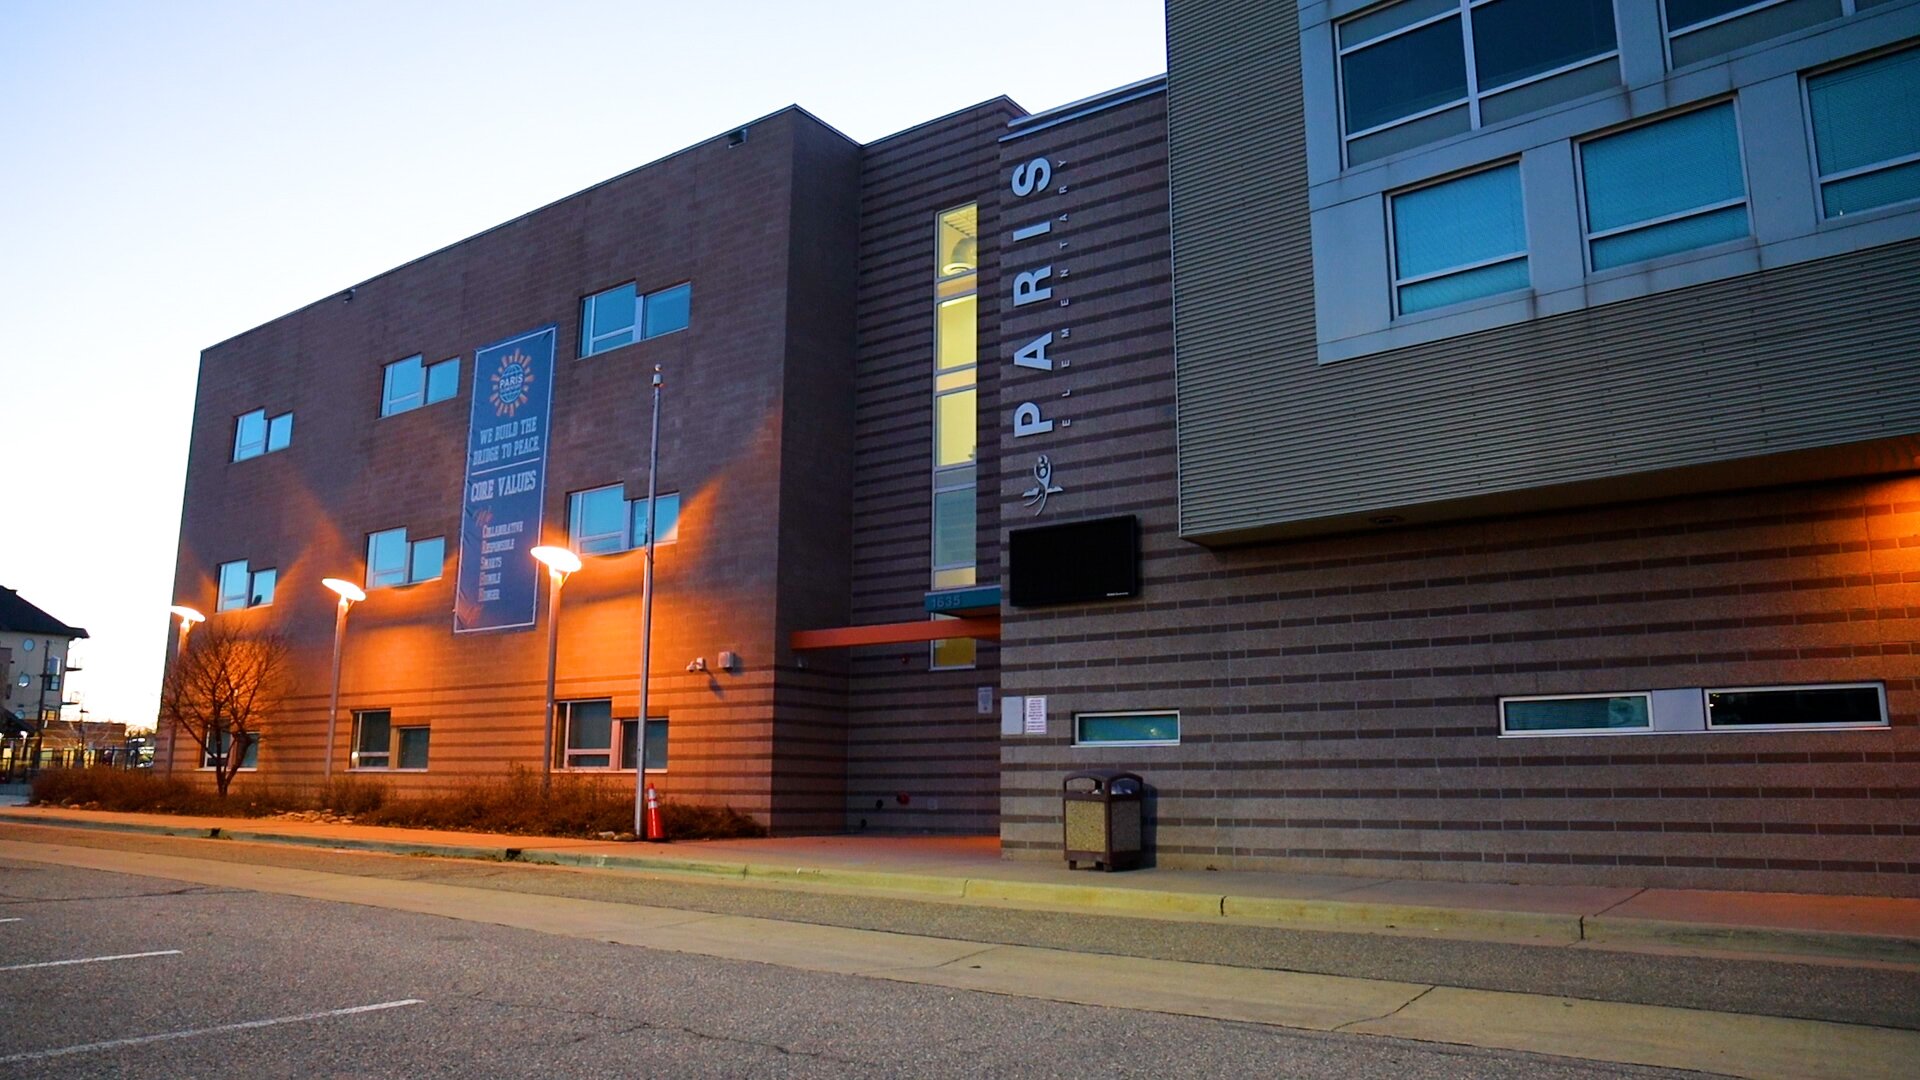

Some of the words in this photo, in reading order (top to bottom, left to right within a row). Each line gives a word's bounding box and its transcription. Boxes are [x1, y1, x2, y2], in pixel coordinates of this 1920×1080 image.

[1011, 157, 1054, 438] PARIS
[1058, 160, 1072, 427] ELEMENTARY
[499, 373, 524, 390] PARIS
[480, 428, 493, 445] WE
[494, 421, 518, 441] BUILD
[520, 416, 537, 435] THE
[473, 445, 500, 466] BRIDGE
[501, 442, 512, 459] TO
[514, 436, 540, 457] PEACE
[471, 479, 494, 502] CORE
[498, 469, 537, 497] VALUES
[931, 594, 961, 609] 1635
